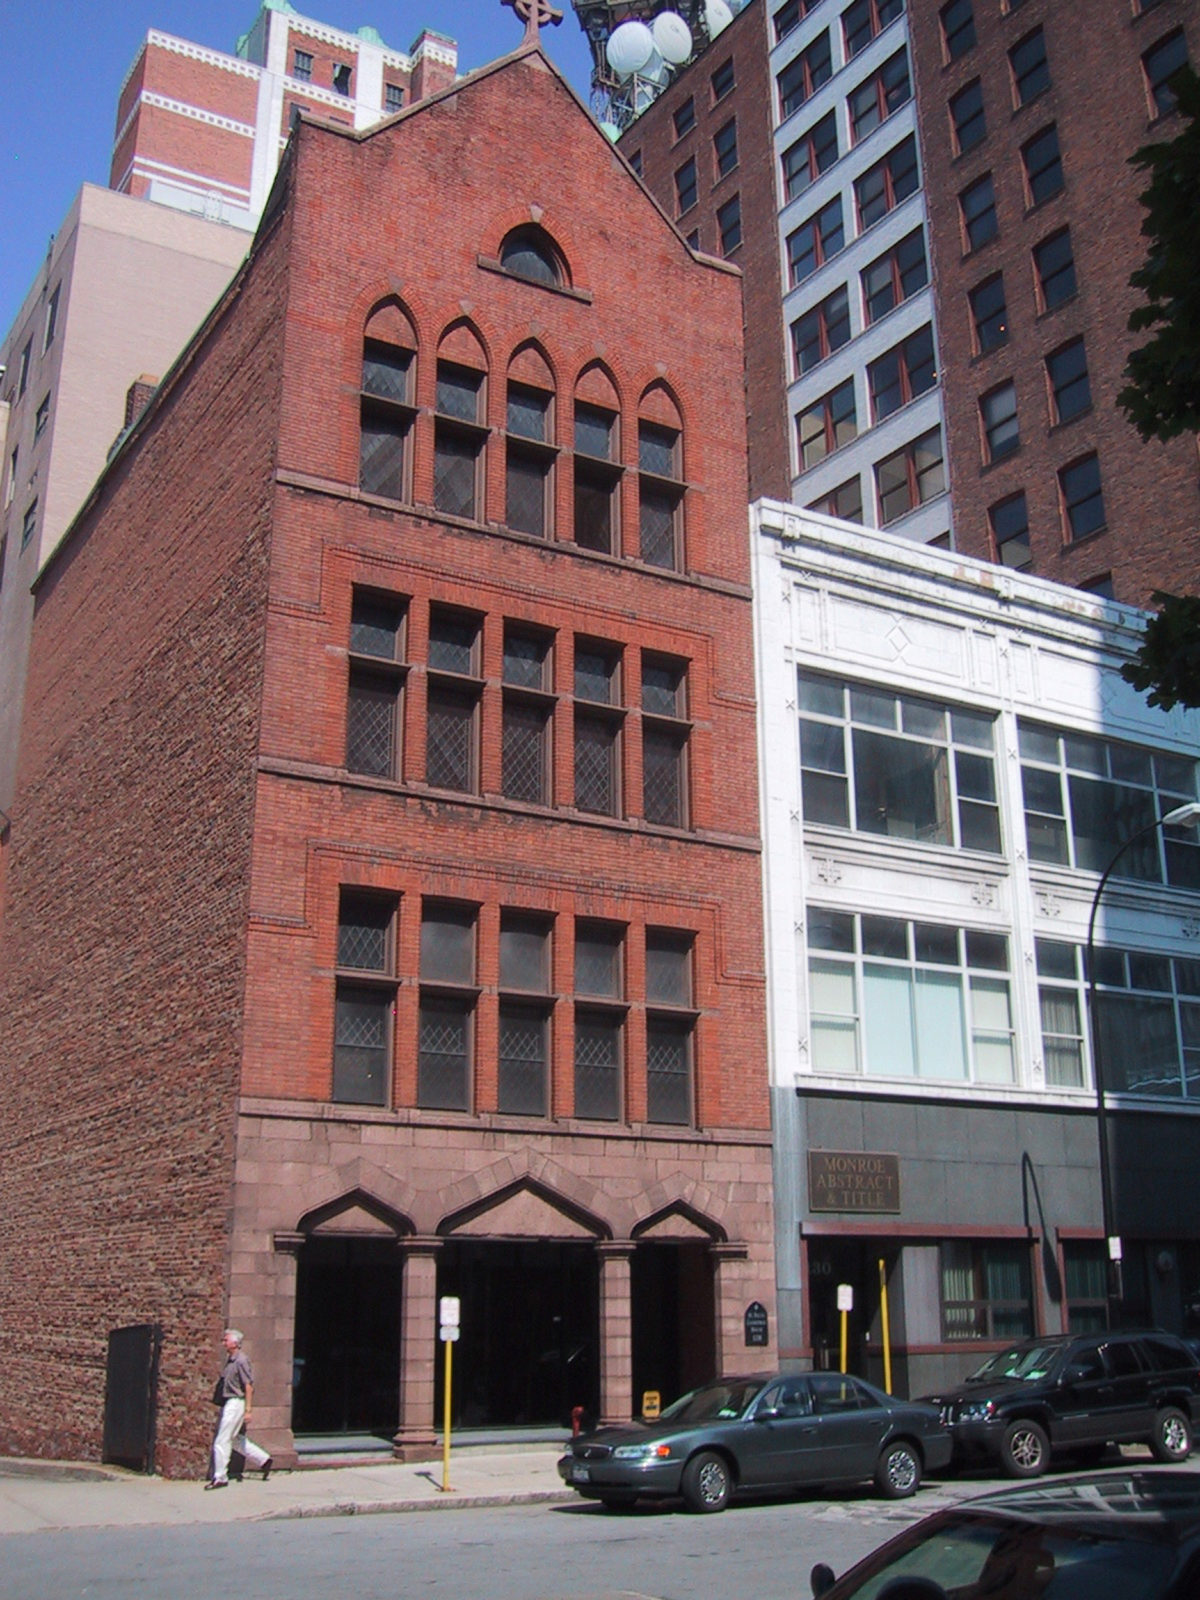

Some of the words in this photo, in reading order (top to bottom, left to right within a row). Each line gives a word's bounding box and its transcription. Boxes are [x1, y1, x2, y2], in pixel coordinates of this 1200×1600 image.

[824, 1157, 886, 1173] MONROE
[816, 1175, 893, 1190] ABSTRACT
[826, 1192, 835, 1205] &
[842, 1191, 886, 1206] TITLE
